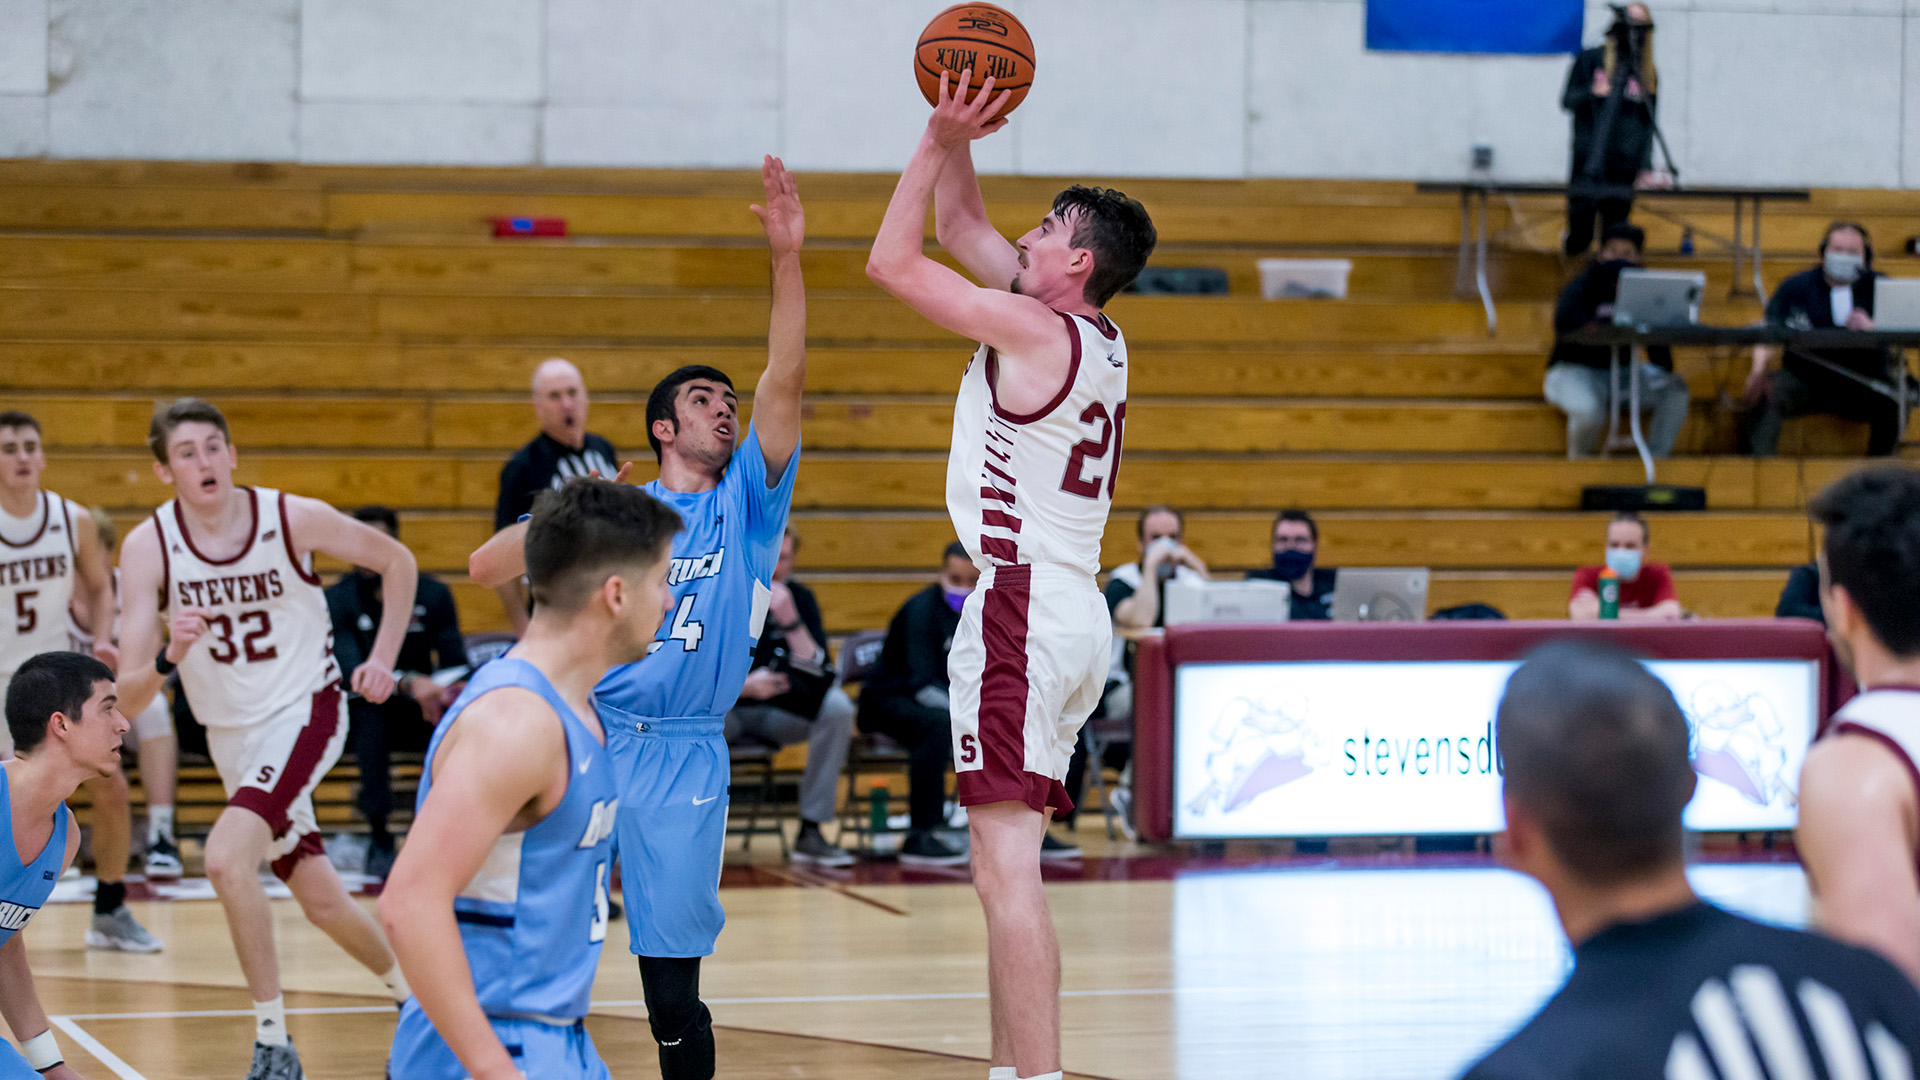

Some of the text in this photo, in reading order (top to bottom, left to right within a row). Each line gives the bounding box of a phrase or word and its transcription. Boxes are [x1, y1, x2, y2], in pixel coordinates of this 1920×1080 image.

[935, 48, 1017, 79] THE ROCK
[0, 555, 66, 586] TEVENS
[177, 568, 284, 608] STEVENS
[15, 590, 39, 635] 5
[648, 593, 704, 653] 4
[204, 609, 278, 665] 32
[960, 734, 977, 763] S
[256, 765, 275, 784] S
